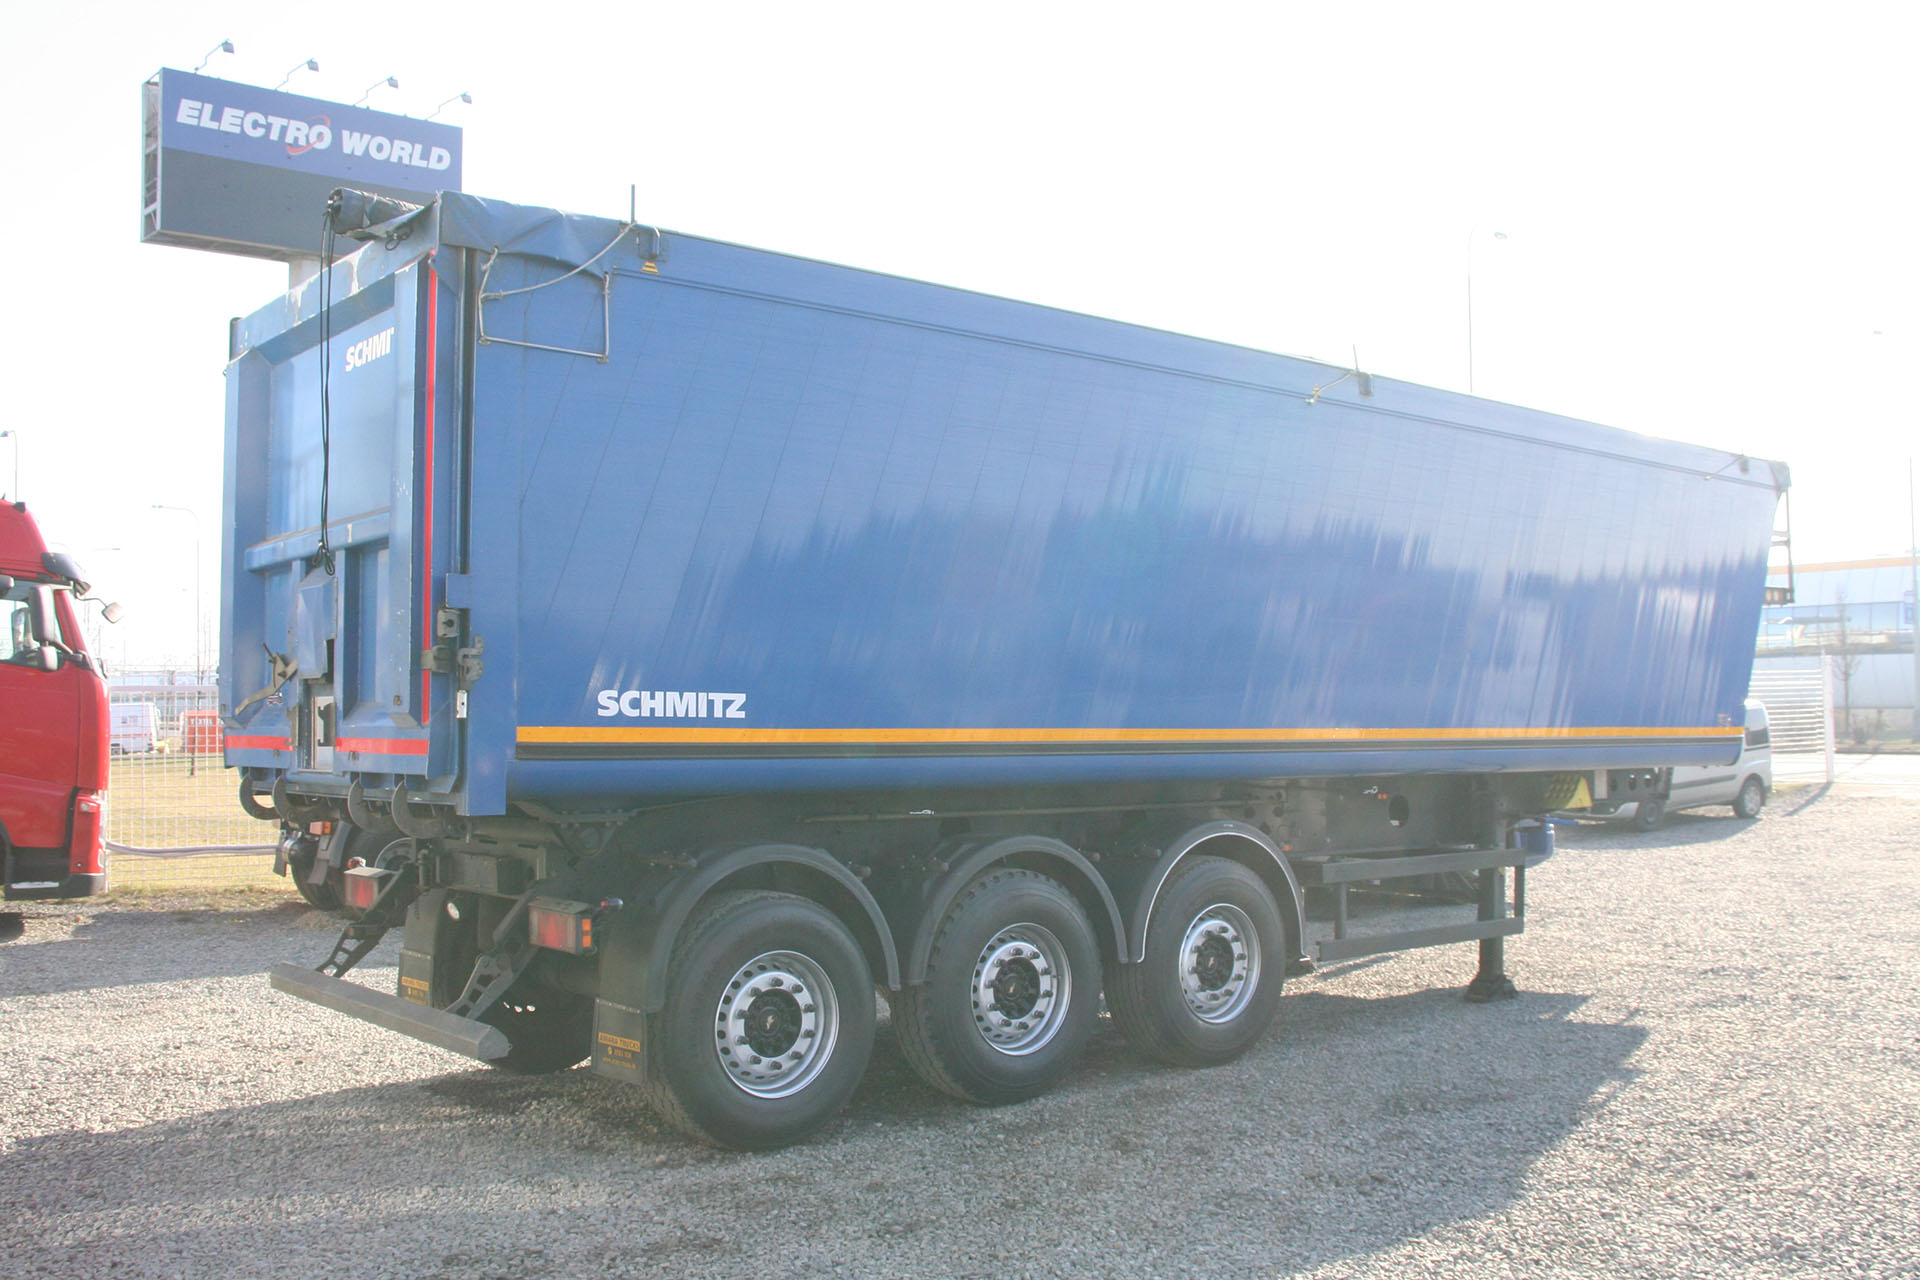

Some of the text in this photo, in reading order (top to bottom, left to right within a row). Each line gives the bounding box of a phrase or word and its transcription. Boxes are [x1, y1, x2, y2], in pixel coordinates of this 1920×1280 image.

[176, 98, 451, 171] ELECTRO WORLD
[597, 689, 747, 719] SCHMITZ
